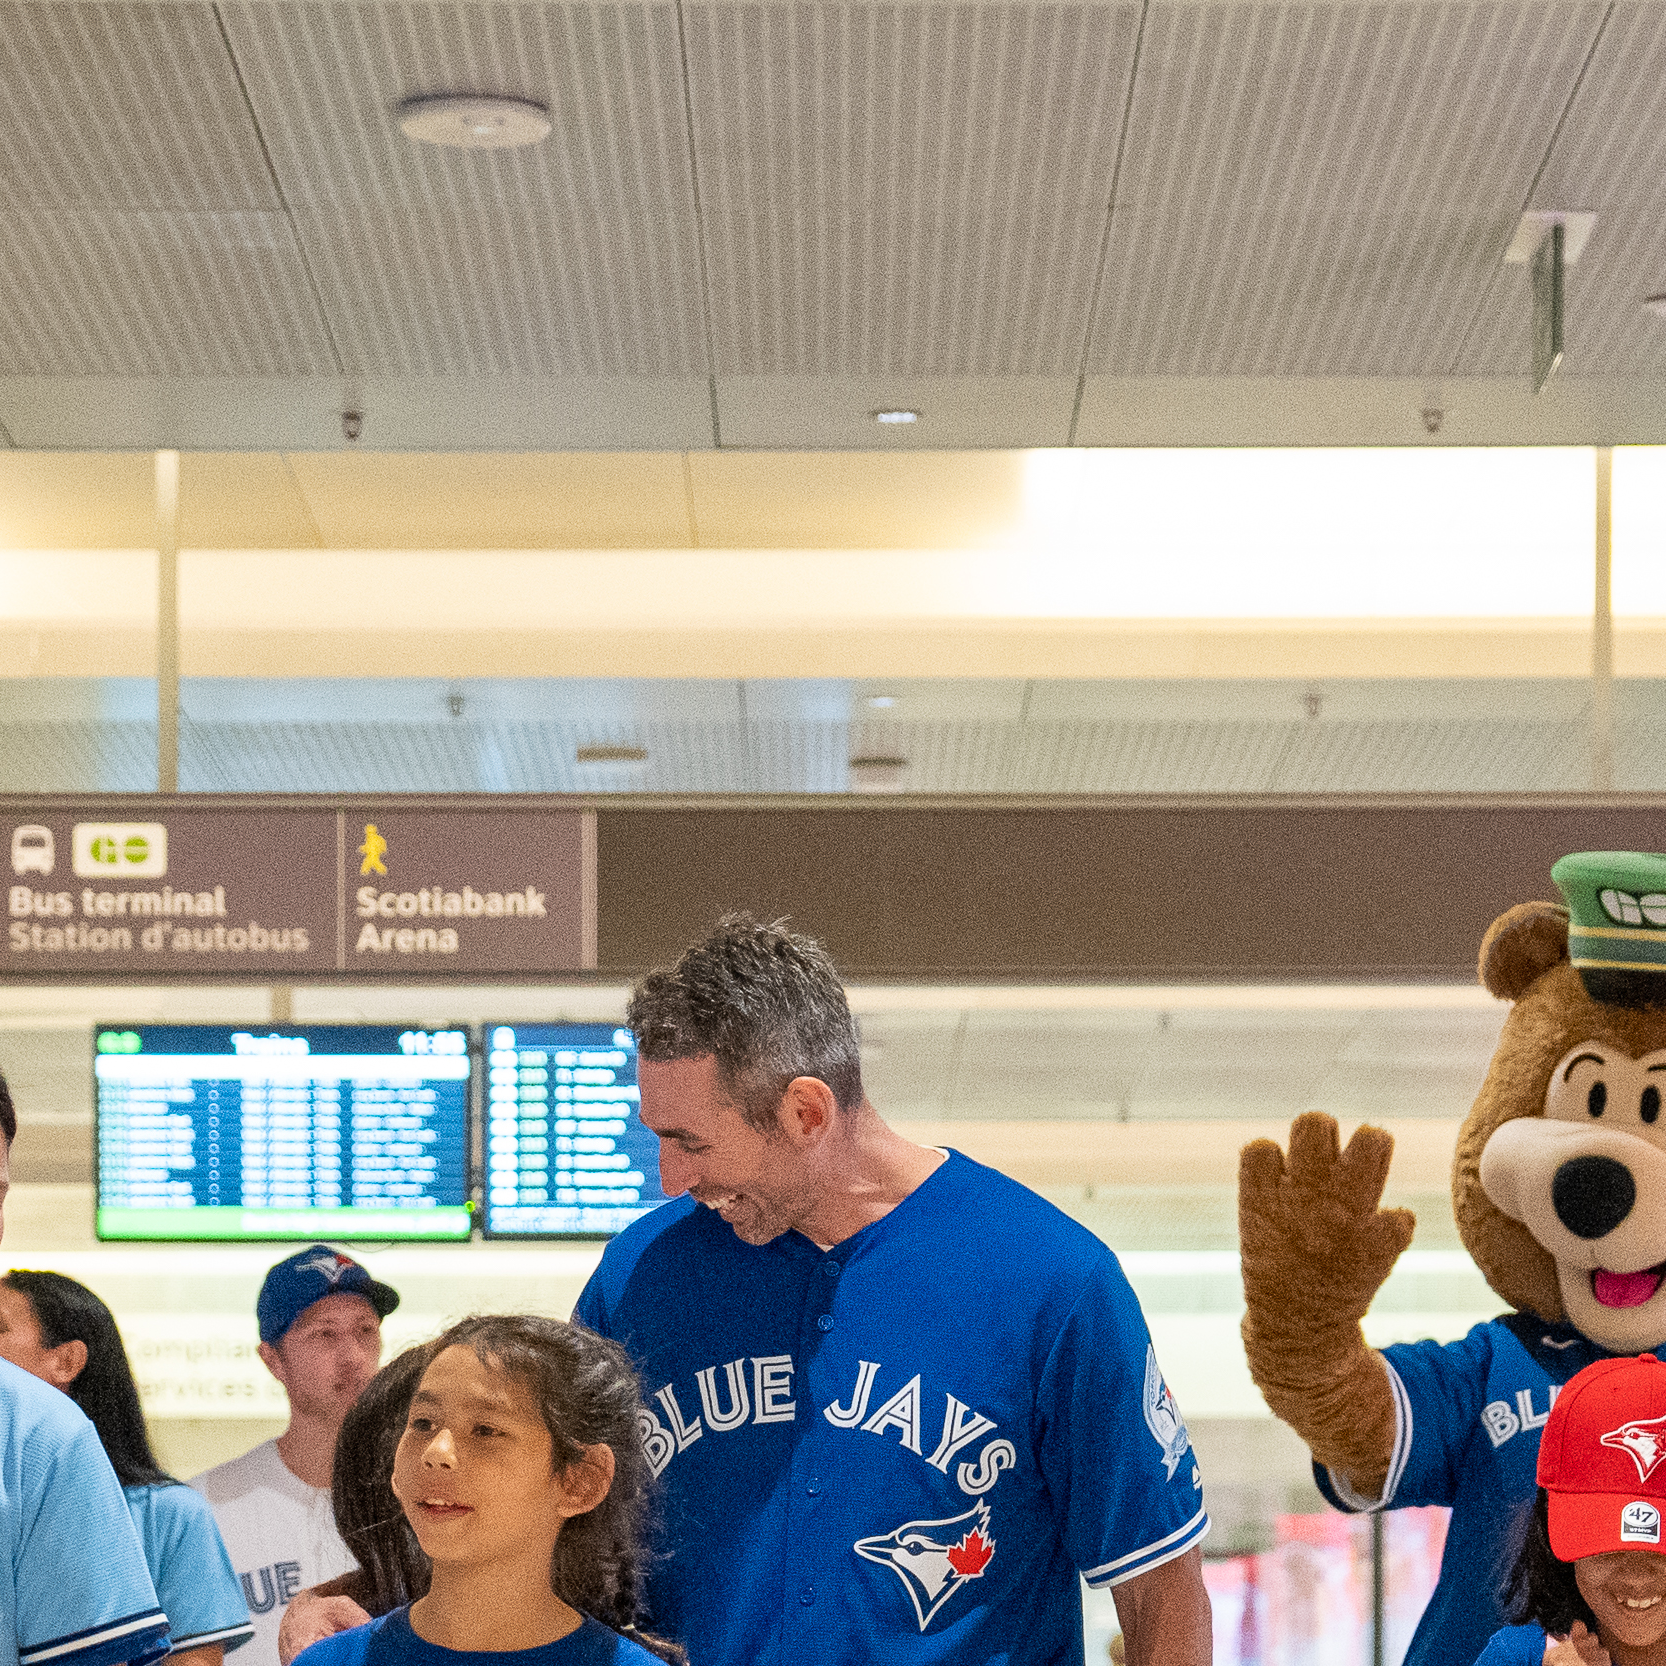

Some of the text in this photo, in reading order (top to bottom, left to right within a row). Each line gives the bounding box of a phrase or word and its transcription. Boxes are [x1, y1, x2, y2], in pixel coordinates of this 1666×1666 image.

[9, 886, 228, 917] Bus terminal
[355, 886, 547, 918] Scotiabank
[9, 922, 310, 953] Station d'autobus
[355, 923, 460, 954] Arena
[638, 1354, 1017, 1496] BLUE JAYS
[1480, 1385, 1562, 1449] BL
[238, 1560, 302, 1614] UE
